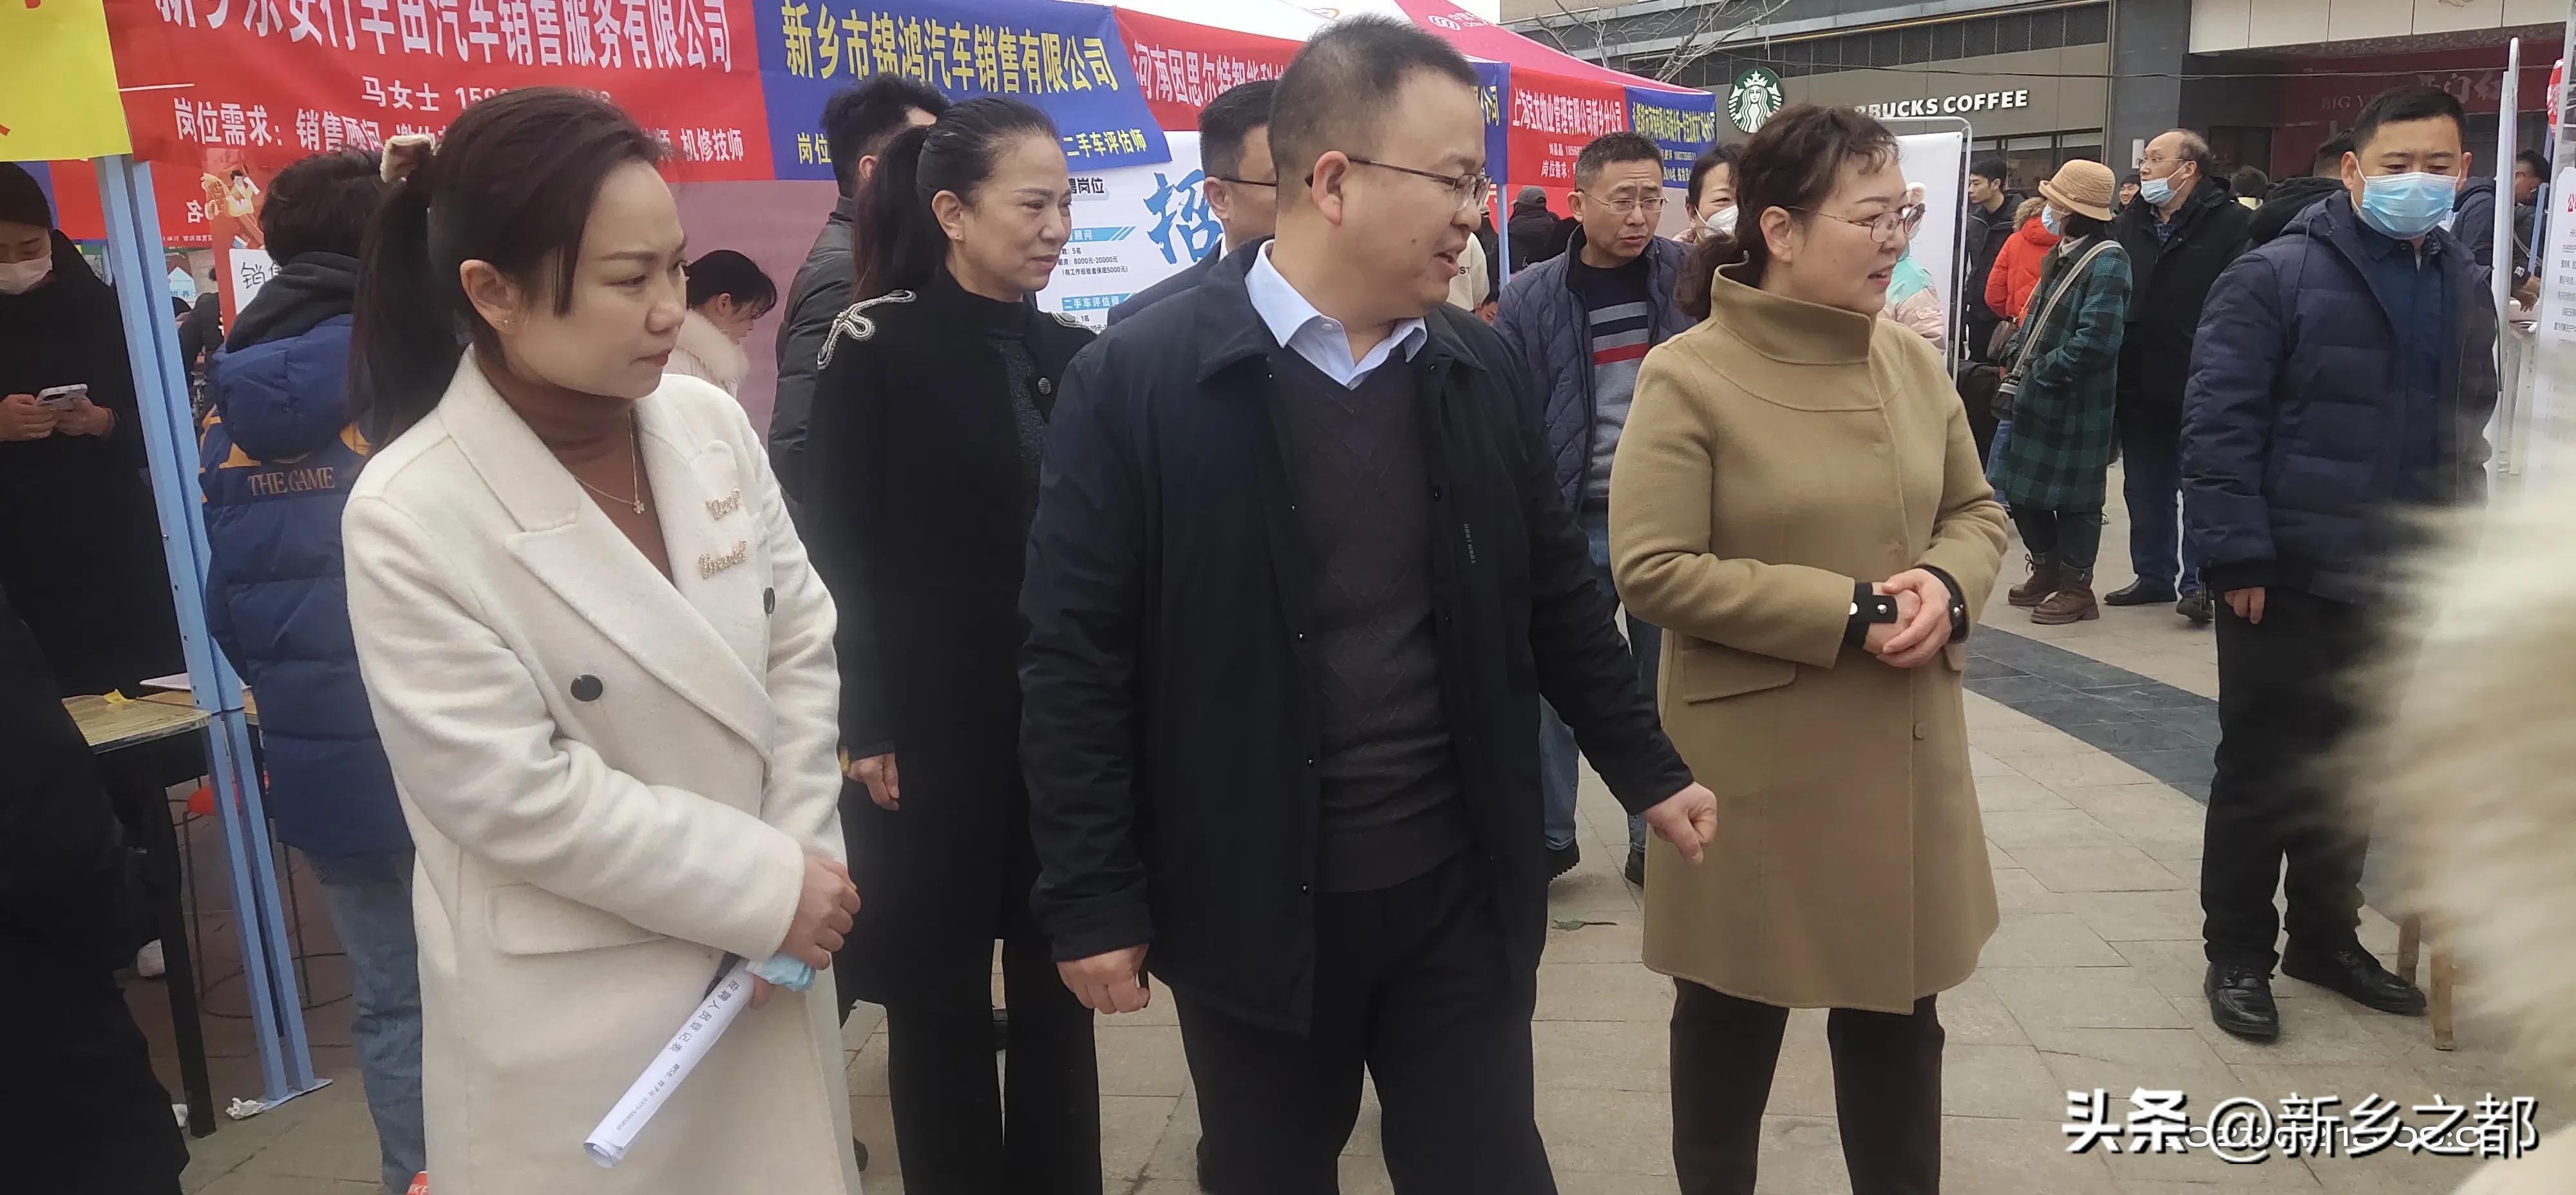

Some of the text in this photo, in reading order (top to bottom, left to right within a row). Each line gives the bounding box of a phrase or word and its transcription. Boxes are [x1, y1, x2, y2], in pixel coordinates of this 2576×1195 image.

[781, 0, 1119, 94] 新乡市锦鸿汽车销售有限公司
[361, 76, 439, 111] 马女士
[1943, 89, 2028, 113] COFFEE
[681, 127, 744, 162] 机修技师
[797, 132, 831, 165] 岗位
[1063, 128, 1148, 158] 二手车评估师
[1143, 169, 1223, 265] 招
[1069, 229, 1092, 241] 顾问
[247, 467, 335, 496] THE GAME
[668, 979, 741, 1054] 应聘人员登记表
